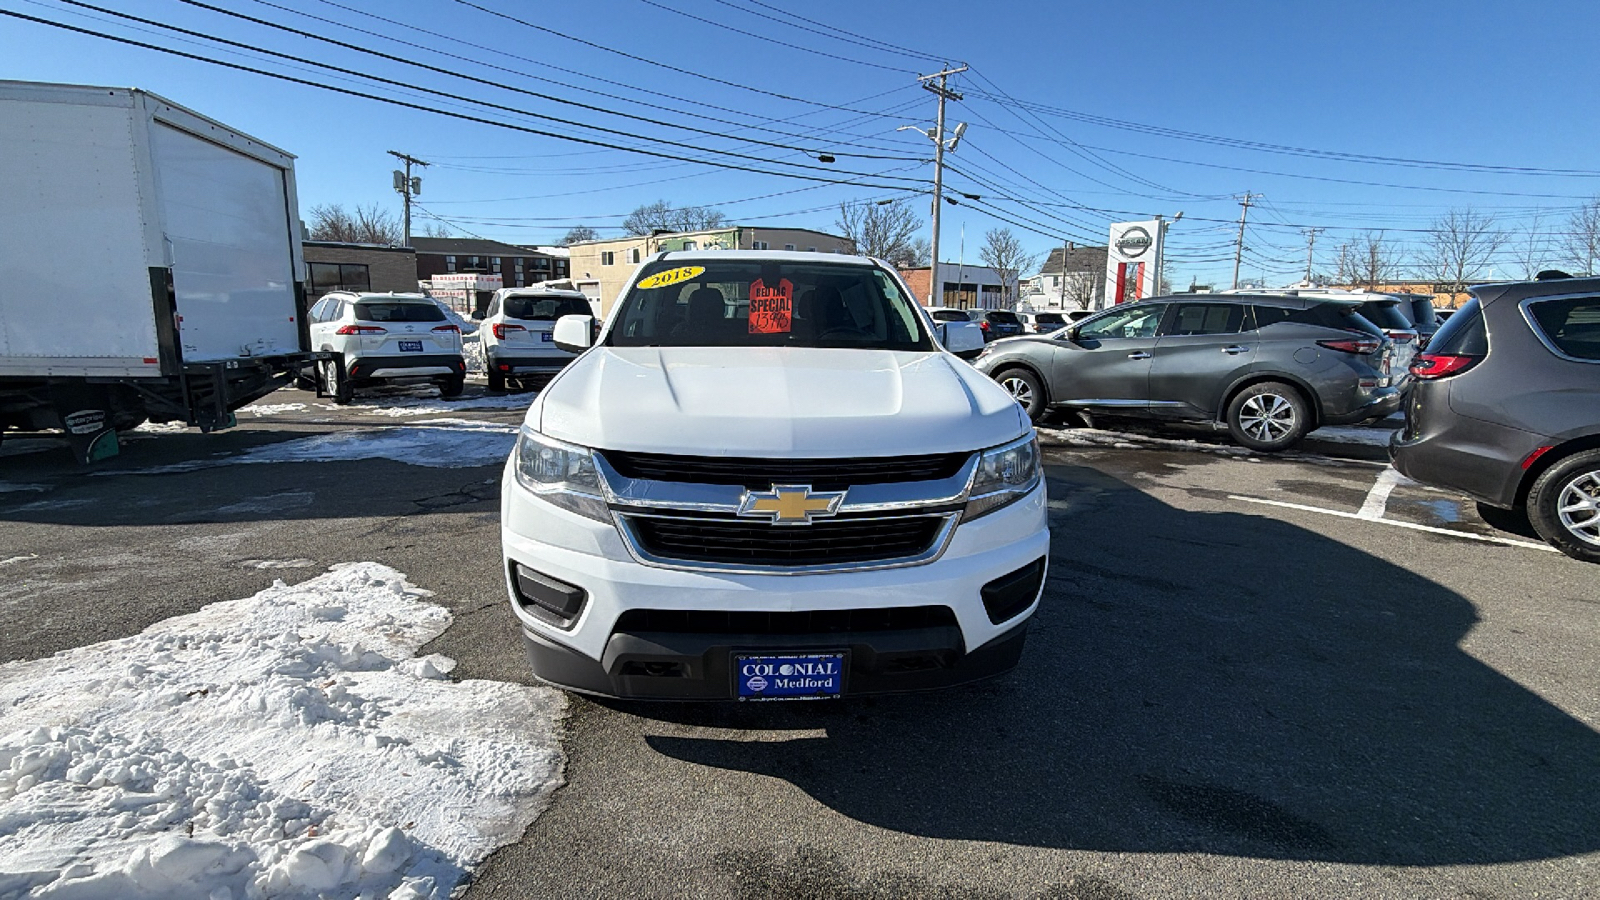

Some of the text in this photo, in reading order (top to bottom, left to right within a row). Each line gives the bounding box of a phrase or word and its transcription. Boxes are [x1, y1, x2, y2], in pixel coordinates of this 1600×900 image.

[651, 267, 693, 287] 2018
[756, 286, 786, 297] RED TAG
[750, 298, 790, 313] SPECIAL
[742, 662, 838, 677] COLONIAL
[774, 678, 833, 689] Medford
